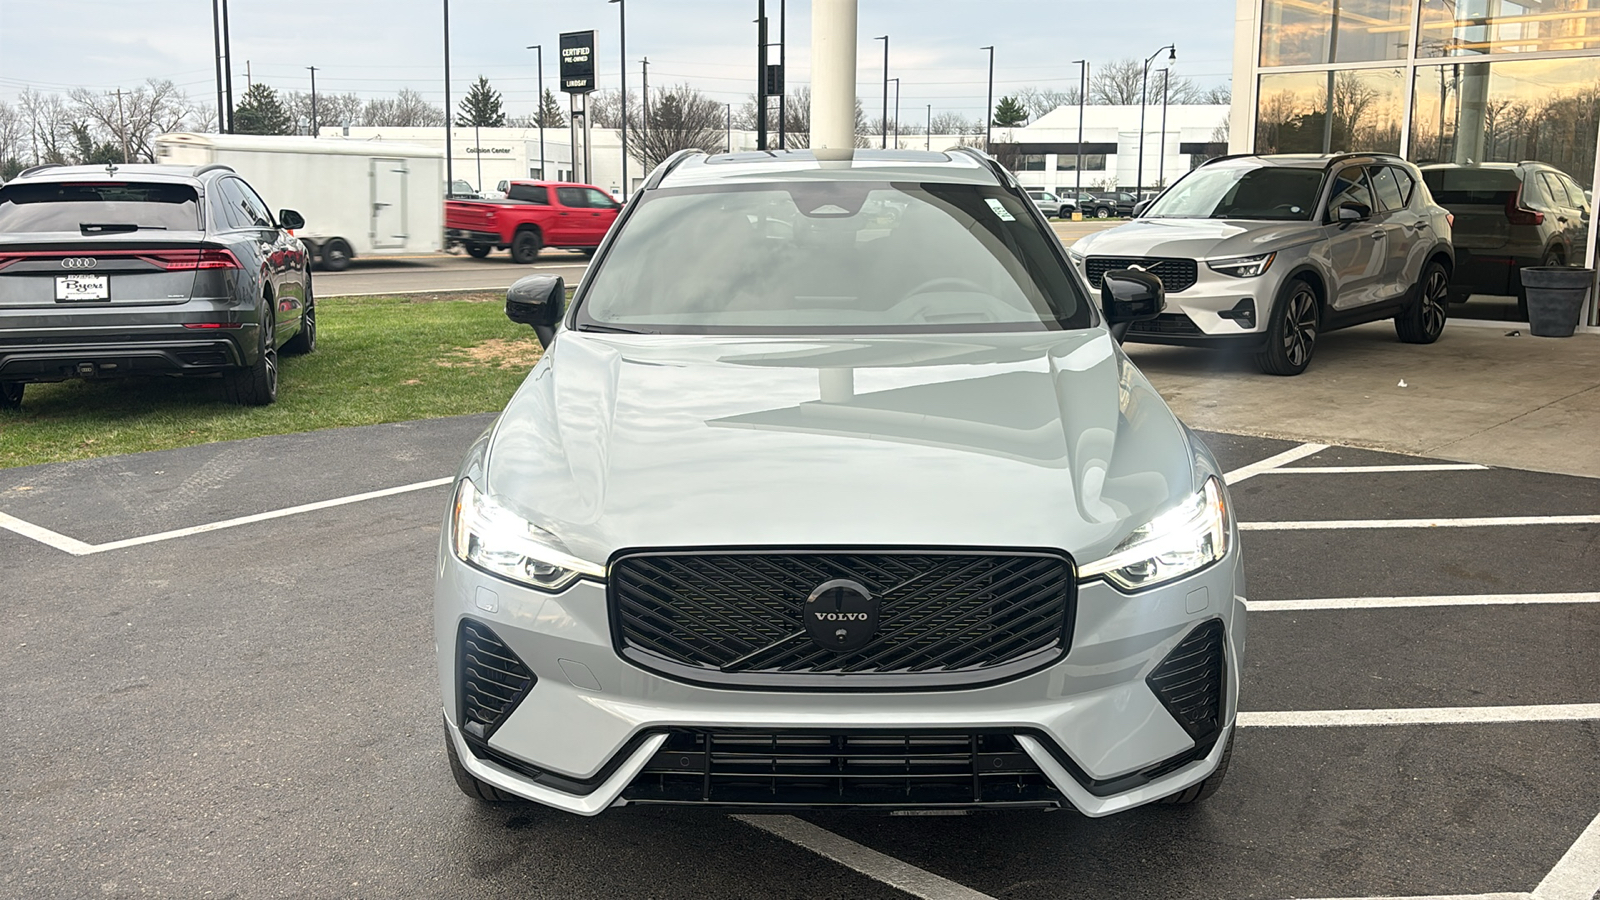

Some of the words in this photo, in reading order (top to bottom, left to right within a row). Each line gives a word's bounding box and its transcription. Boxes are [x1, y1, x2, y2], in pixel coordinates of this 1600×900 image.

[562, 47, 590, 57] CERTIFIED
[61, 279, 103, 292] Byers
[814, 612, 868, 621] VOLVO
